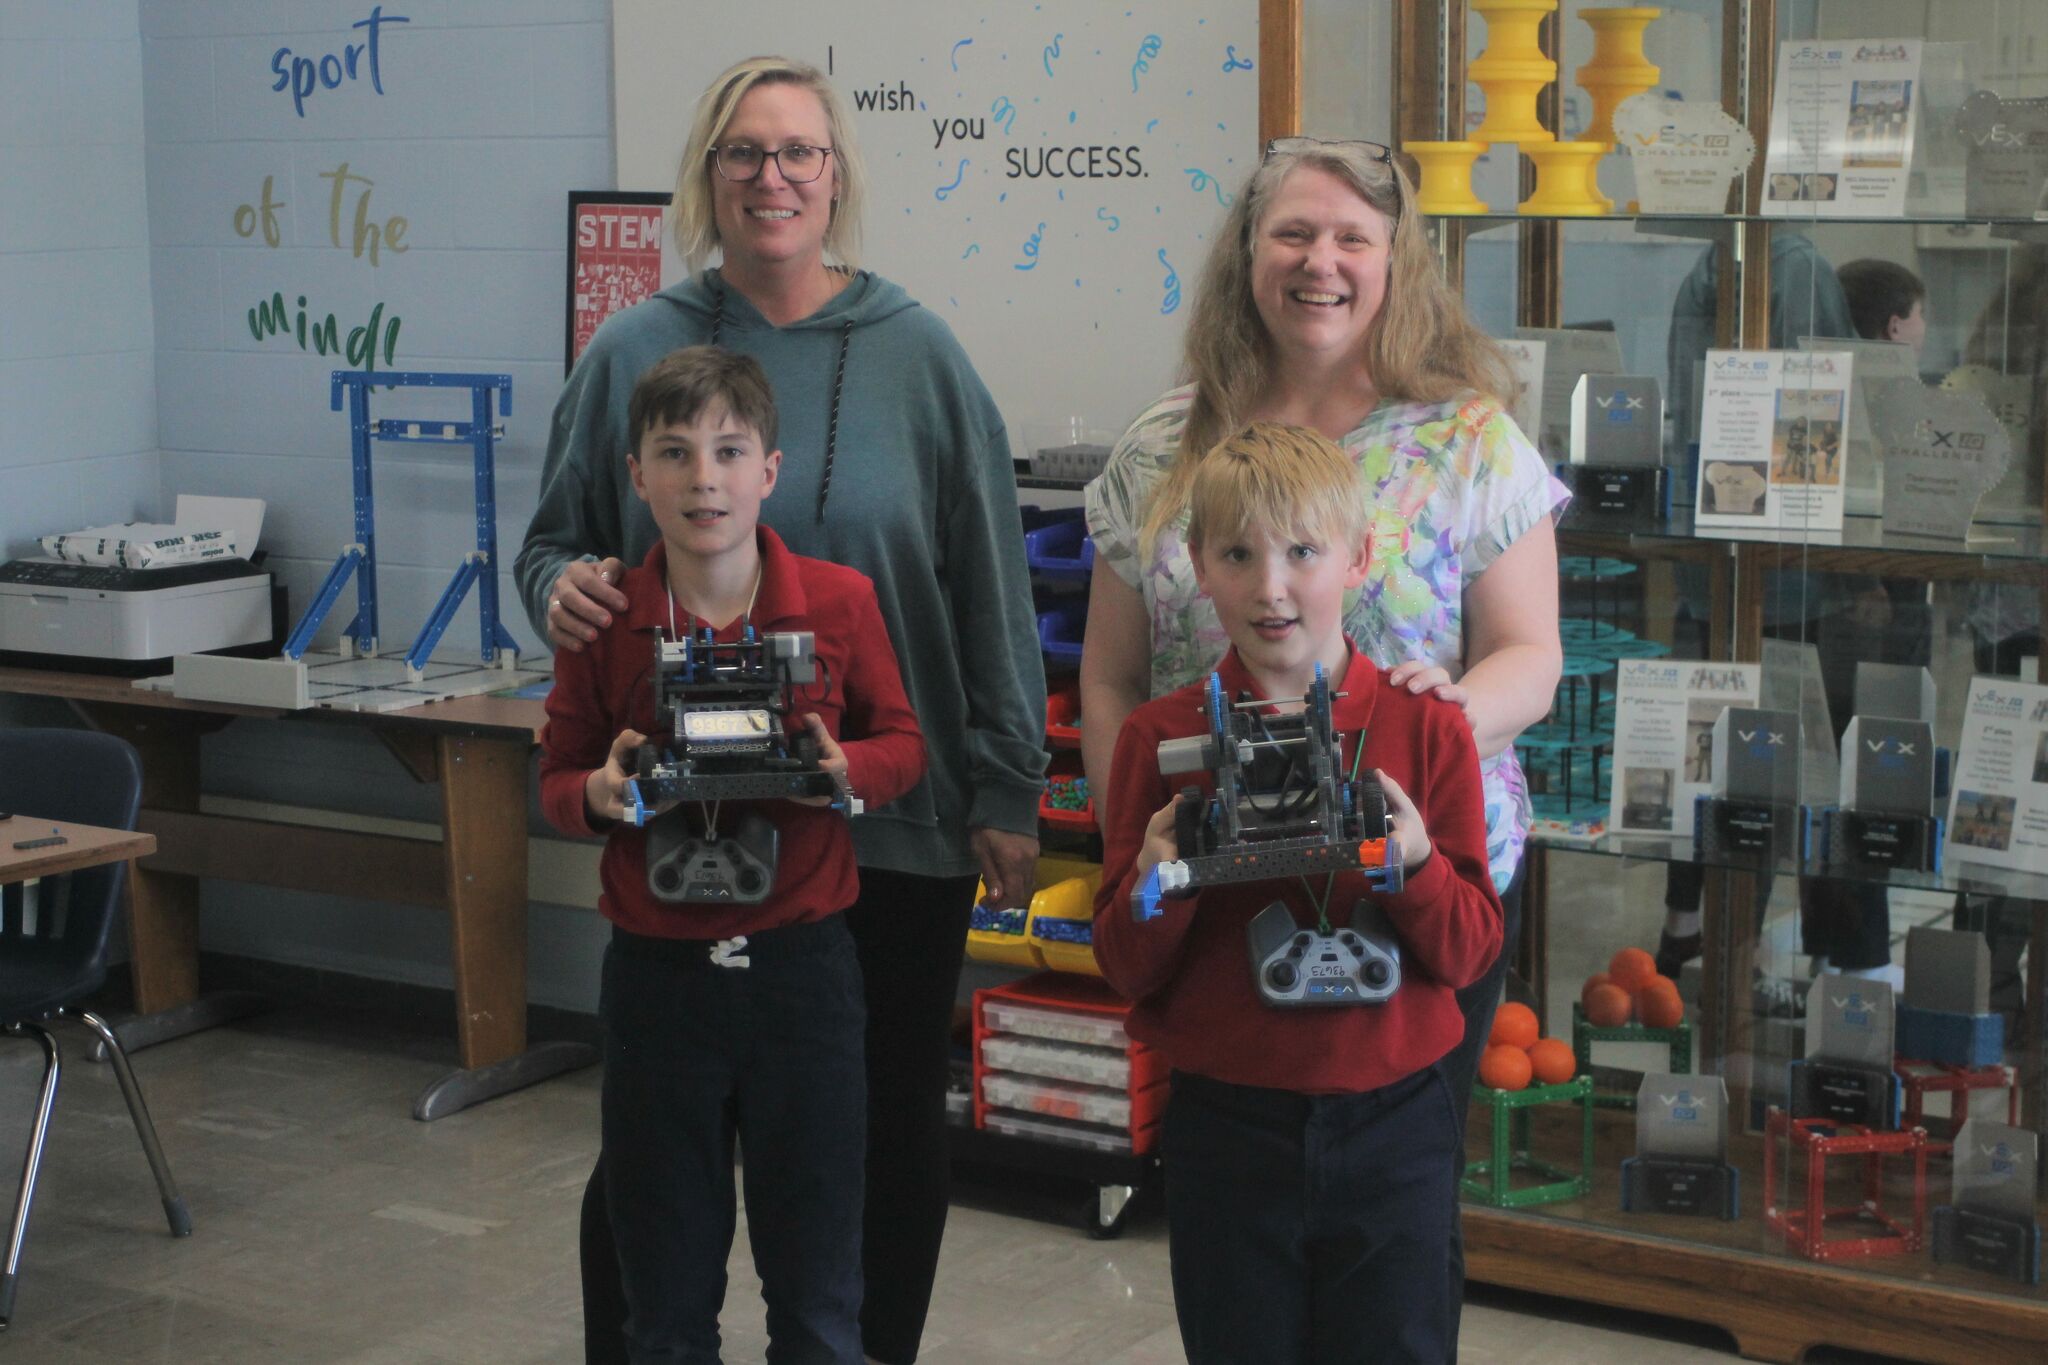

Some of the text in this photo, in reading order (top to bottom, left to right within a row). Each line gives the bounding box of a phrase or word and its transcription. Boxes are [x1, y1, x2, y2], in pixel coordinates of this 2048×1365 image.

[271, 5, 410, 118] sport
[828, 45, 834, 76] I
[853, 80, 916, 111] wish
[932, 117, 985, 149] you
[1005, 145, 1150, 178] SUCCESS.
[233, 162, 409, 268] of the
[578, 214, 662, 250] STEM
[1310, 965, 1345, 977] 93673
